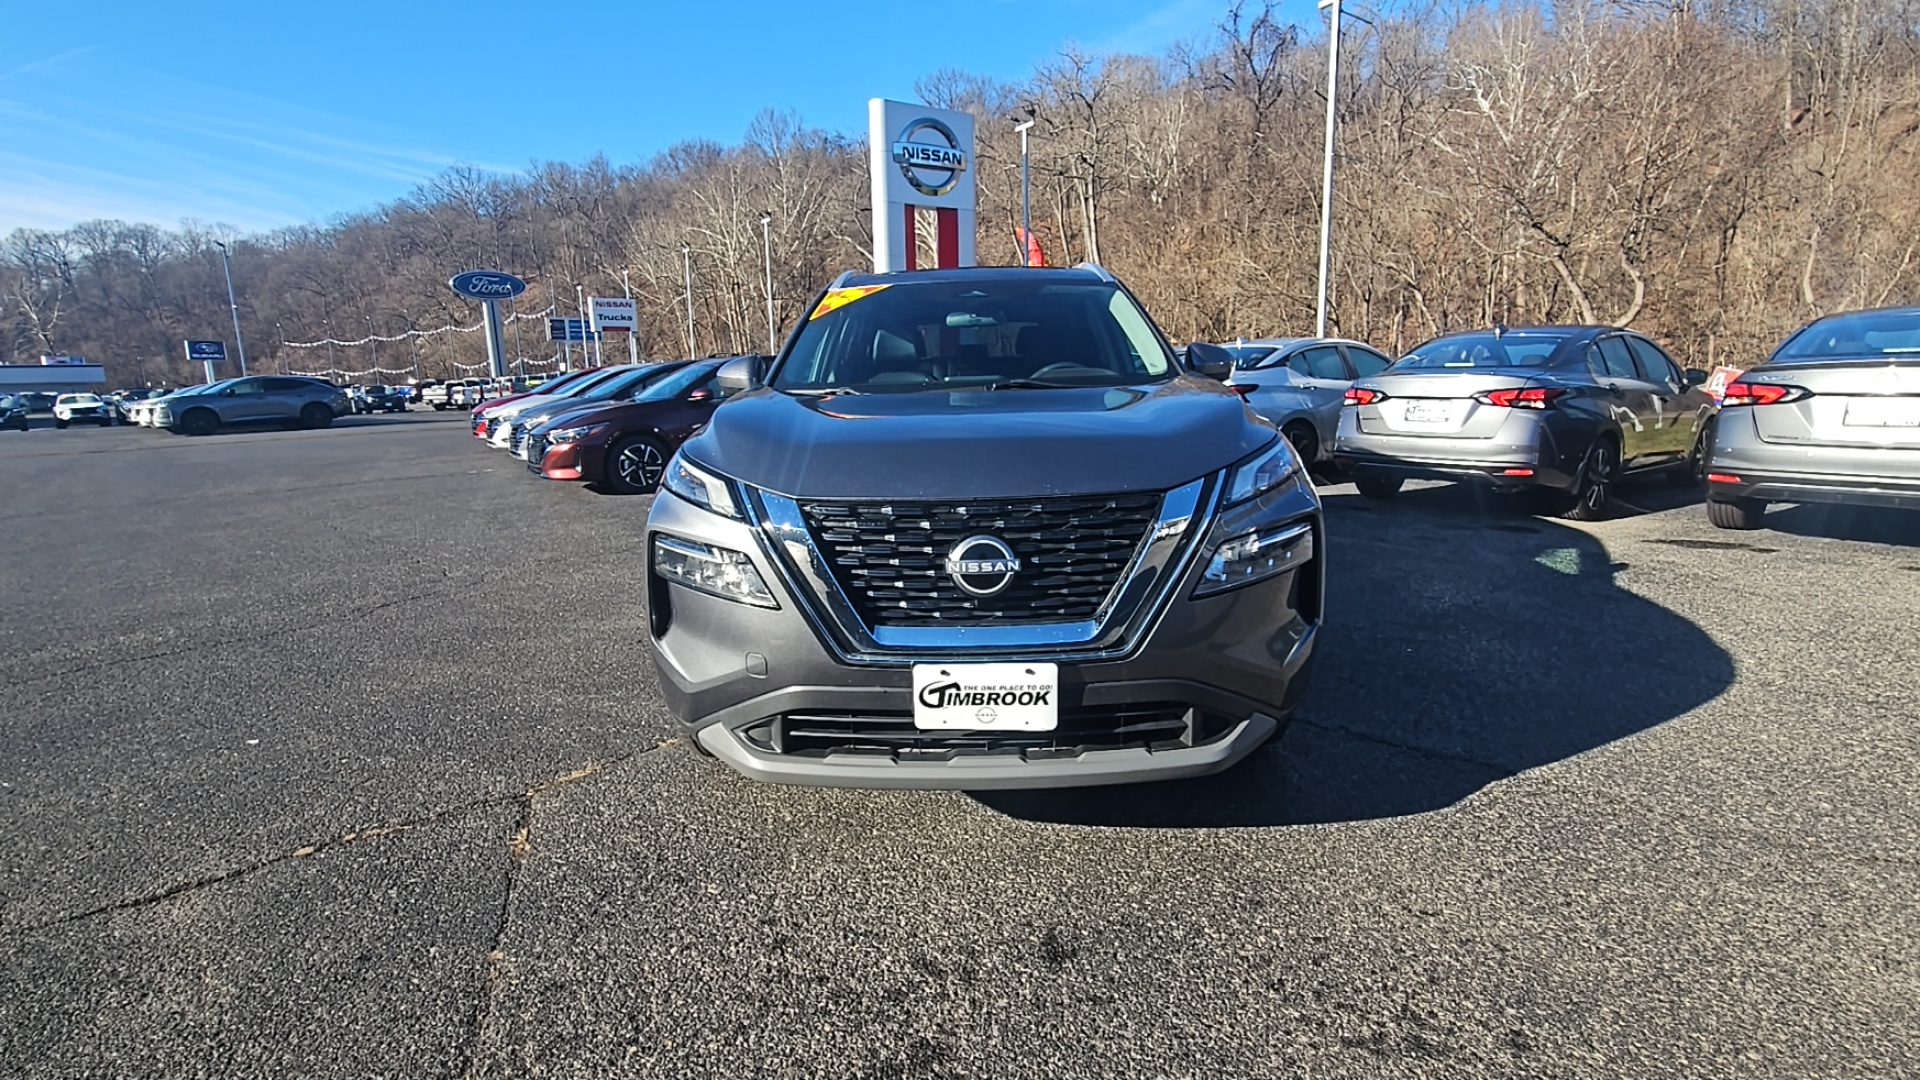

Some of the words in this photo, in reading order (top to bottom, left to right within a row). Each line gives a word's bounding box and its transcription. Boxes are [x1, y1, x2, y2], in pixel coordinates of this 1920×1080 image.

[902, 145, 962, 166] NISSAN
[468, 275, 511, 294] Ford
[595, 300, 632, 309] NISSAN
[597, 313, 633, 322] Trucks
[946, 560, 1020, 573] NISSAN
[918, 680, 1052, 709] TIMBROOK
